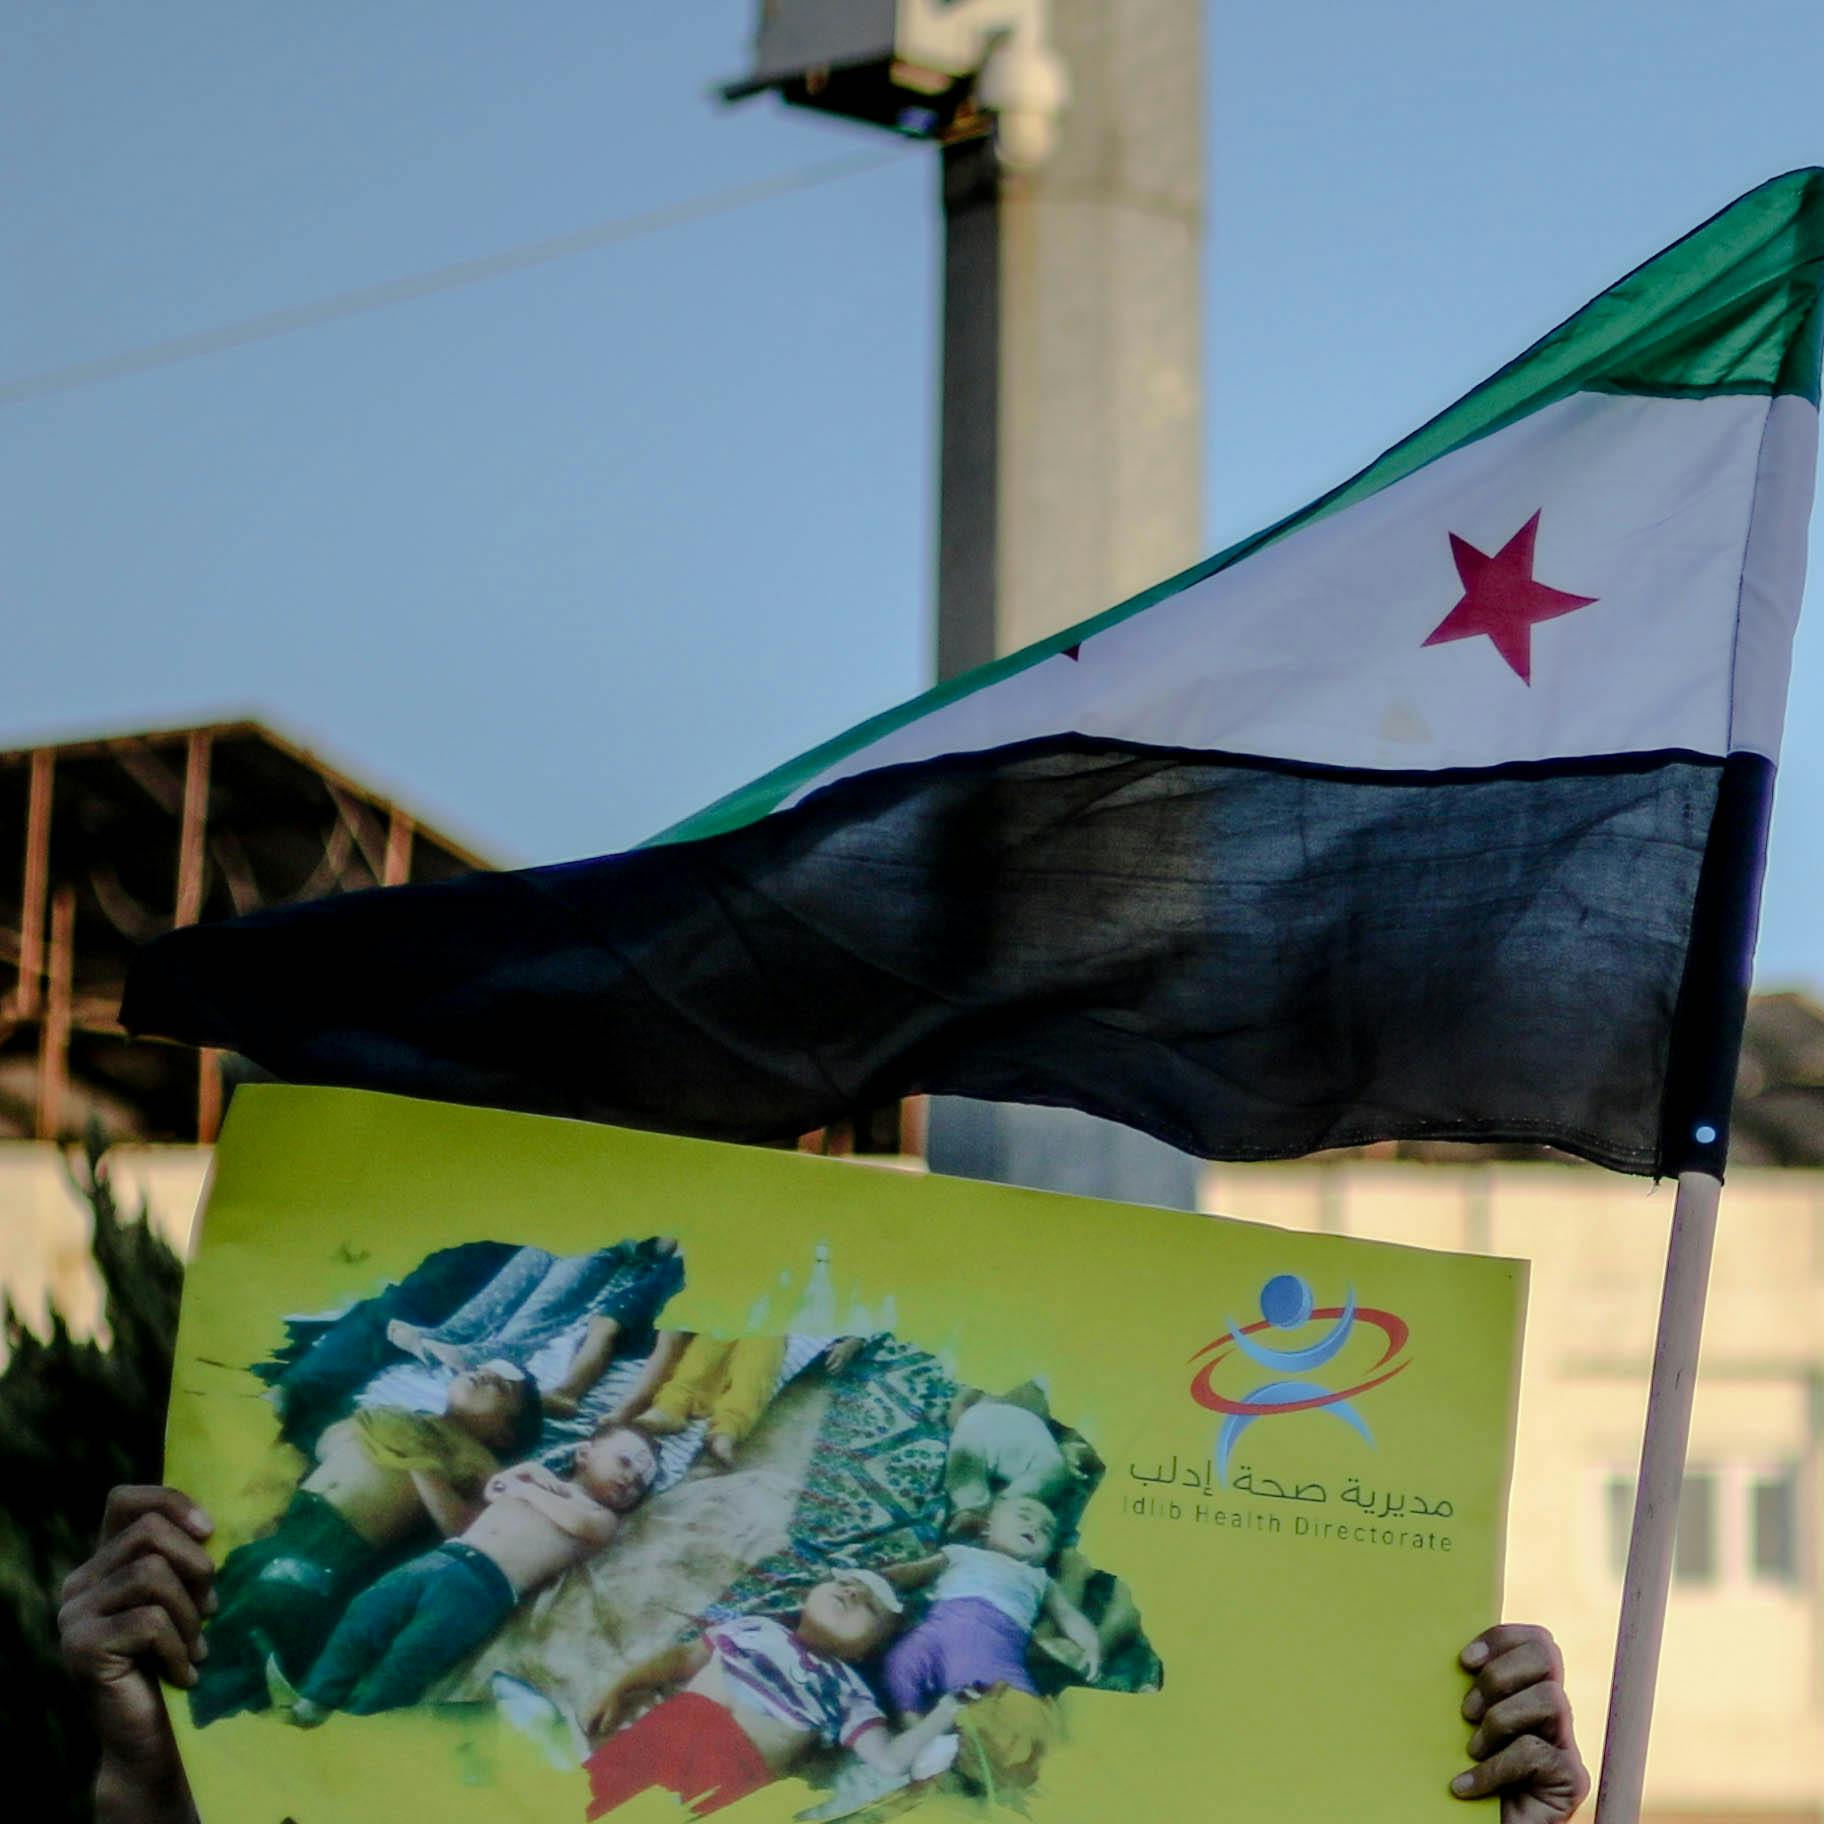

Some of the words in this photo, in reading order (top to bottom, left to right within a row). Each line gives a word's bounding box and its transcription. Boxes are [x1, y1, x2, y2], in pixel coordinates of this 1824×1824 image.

[1130, 1455, 1213, 1496] إدلب
[1232, 1465, 1327, 1503] صحة
[1340, 1477, 1454, 1519] مديرية
[1123, 1495, 1181, 1520] Idlib
[1195, 1504, 1281, 1534] Health
[1294, 1516, 1453, 1552] Directorate
